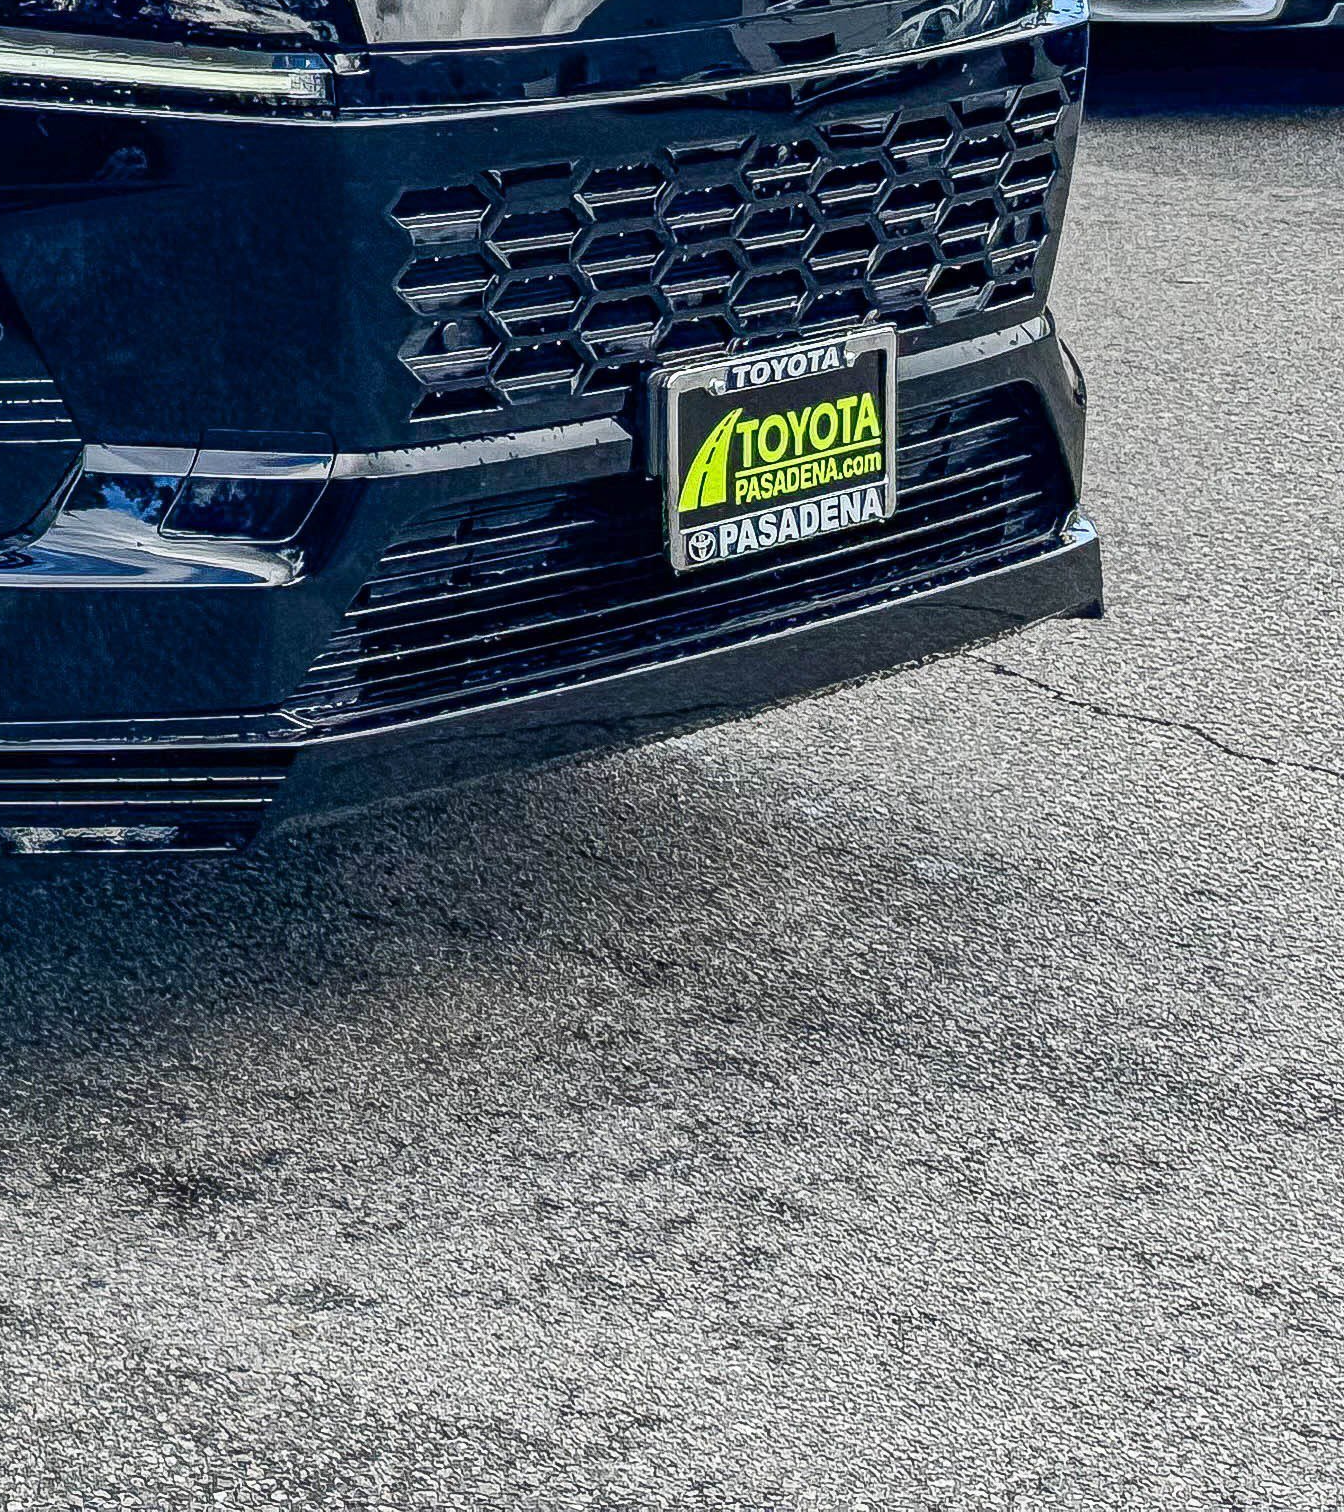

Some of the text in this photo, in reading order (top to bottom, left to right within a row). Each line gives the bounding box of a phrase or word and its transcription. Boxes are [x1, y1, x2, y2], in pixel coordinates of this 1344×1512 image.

[732, 346, 840, 388] TOYOTA
[736, 392, 881, 468] TOYOTA
[735, 450, 882, 505] PASADENA.com
[719, 488, 885, 557] PASADENA
